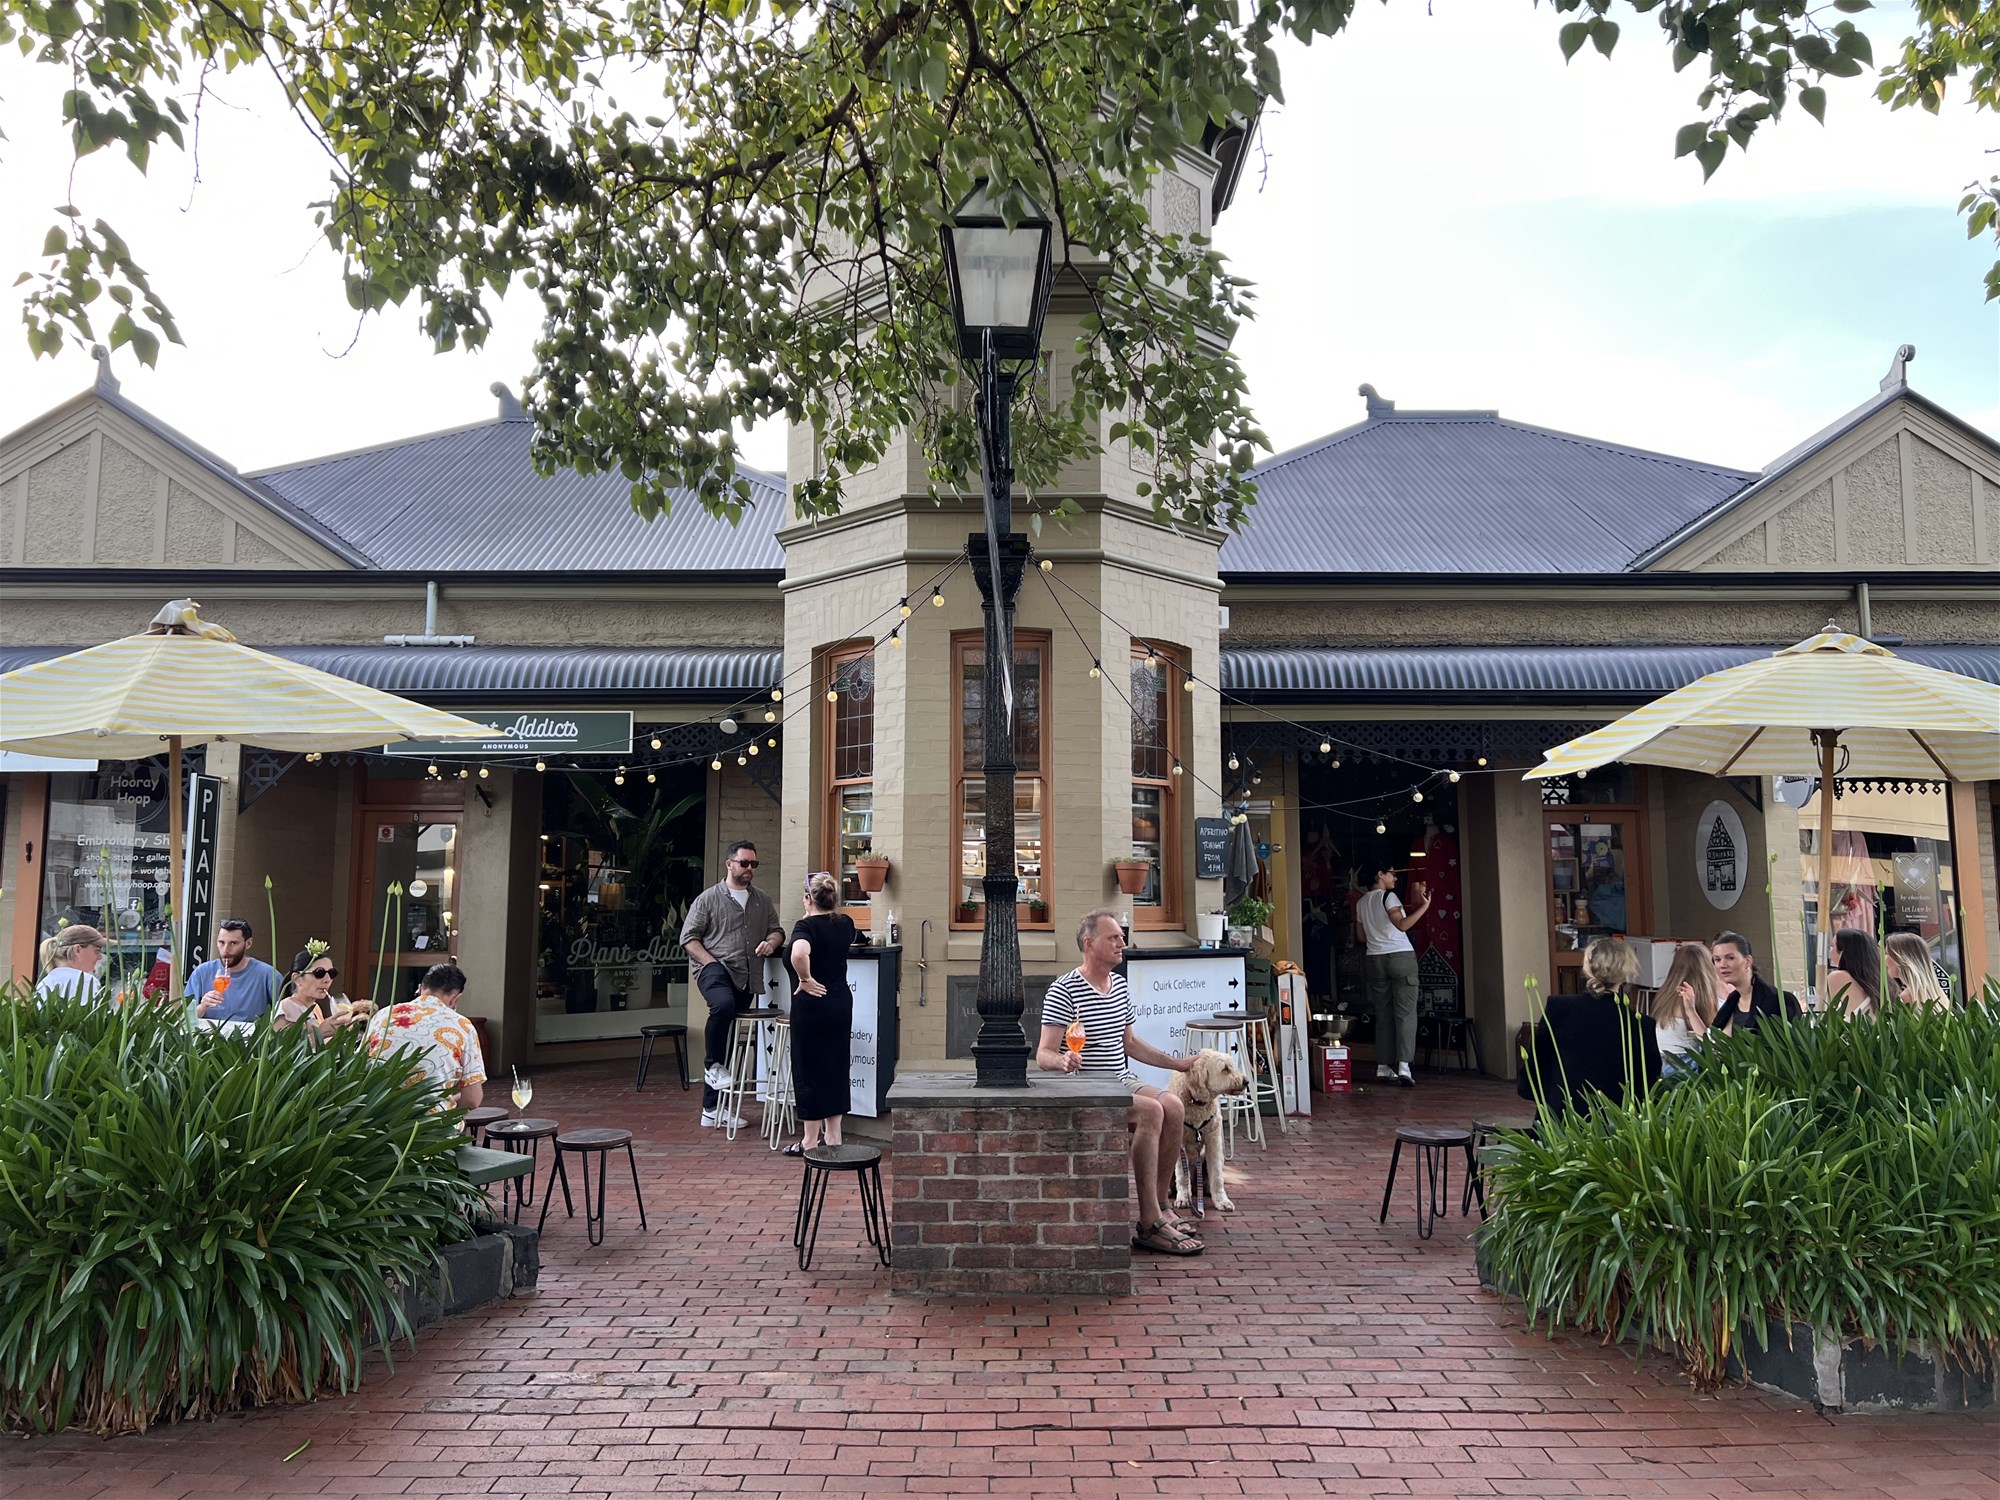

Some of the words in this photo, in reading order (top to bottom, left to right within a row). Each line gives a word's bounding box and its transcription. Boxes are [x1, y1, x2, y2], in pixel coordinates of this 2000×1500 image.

[504, 714, 579, 739] Addicts
[110, 776, 160, 791] Hooray
[116, 792, 151, 807] Hoop
[77, 834, 148, 849] Embroidery
[1202, 841, 1225, 849] TONIGHT
[1204, 853, 1220, 862] FROM
[73, 867, 92, 876] gifts
[192, 788, 213, 970] PLANTS
[566, 938, 633, 965] Plant
[1153, 980, 1172, 991] Quirk
[1173, 978, 1206, 990] Collective
[1133, 1005, 1151, 1018] Tulip
[1153, 1004, 1165, 1015] Bar
[1167, 1002, 1182, 1014] and
[1183, 1001, 1221, 1013] Restaurant
